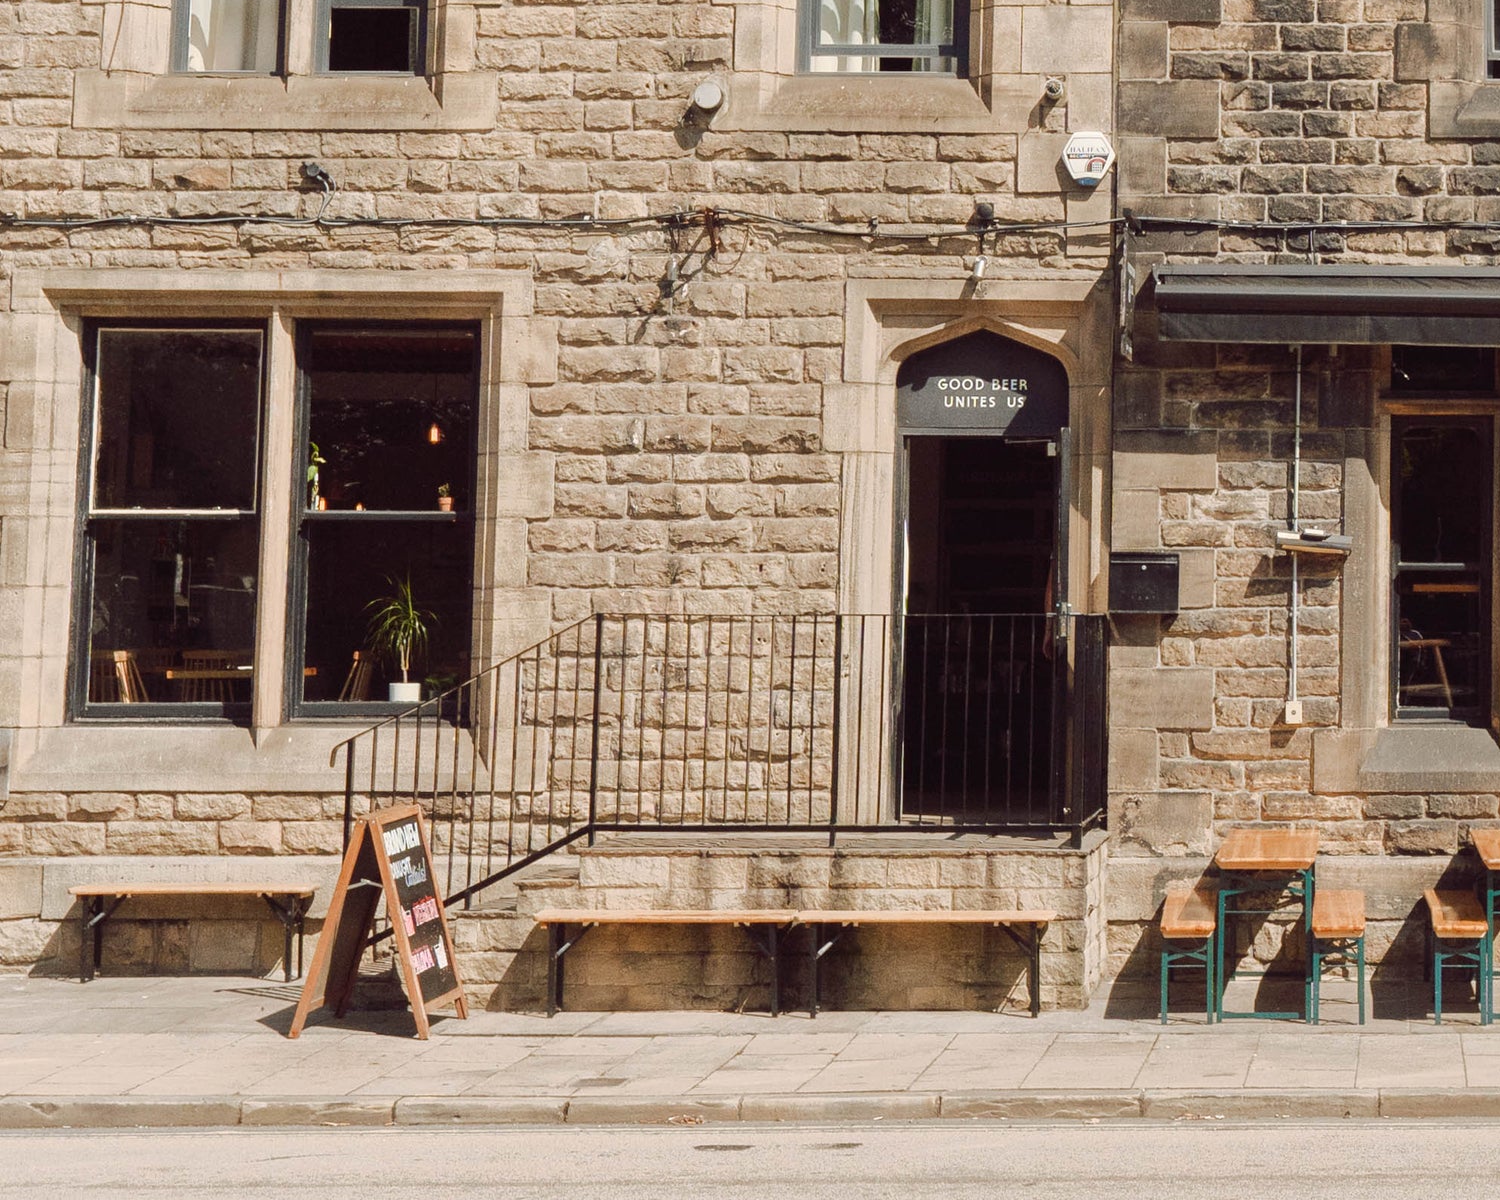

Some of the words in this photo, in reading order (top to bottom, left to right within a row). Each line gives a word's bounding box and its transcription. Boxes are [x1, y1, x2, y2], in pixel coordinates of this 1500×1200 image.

[937, 378, 984, 391] GOOD
[991, 378, 1028, 391] BEER
[943, 396, 996, 408] UNITES
[1006, 396, 1025, 408] US
